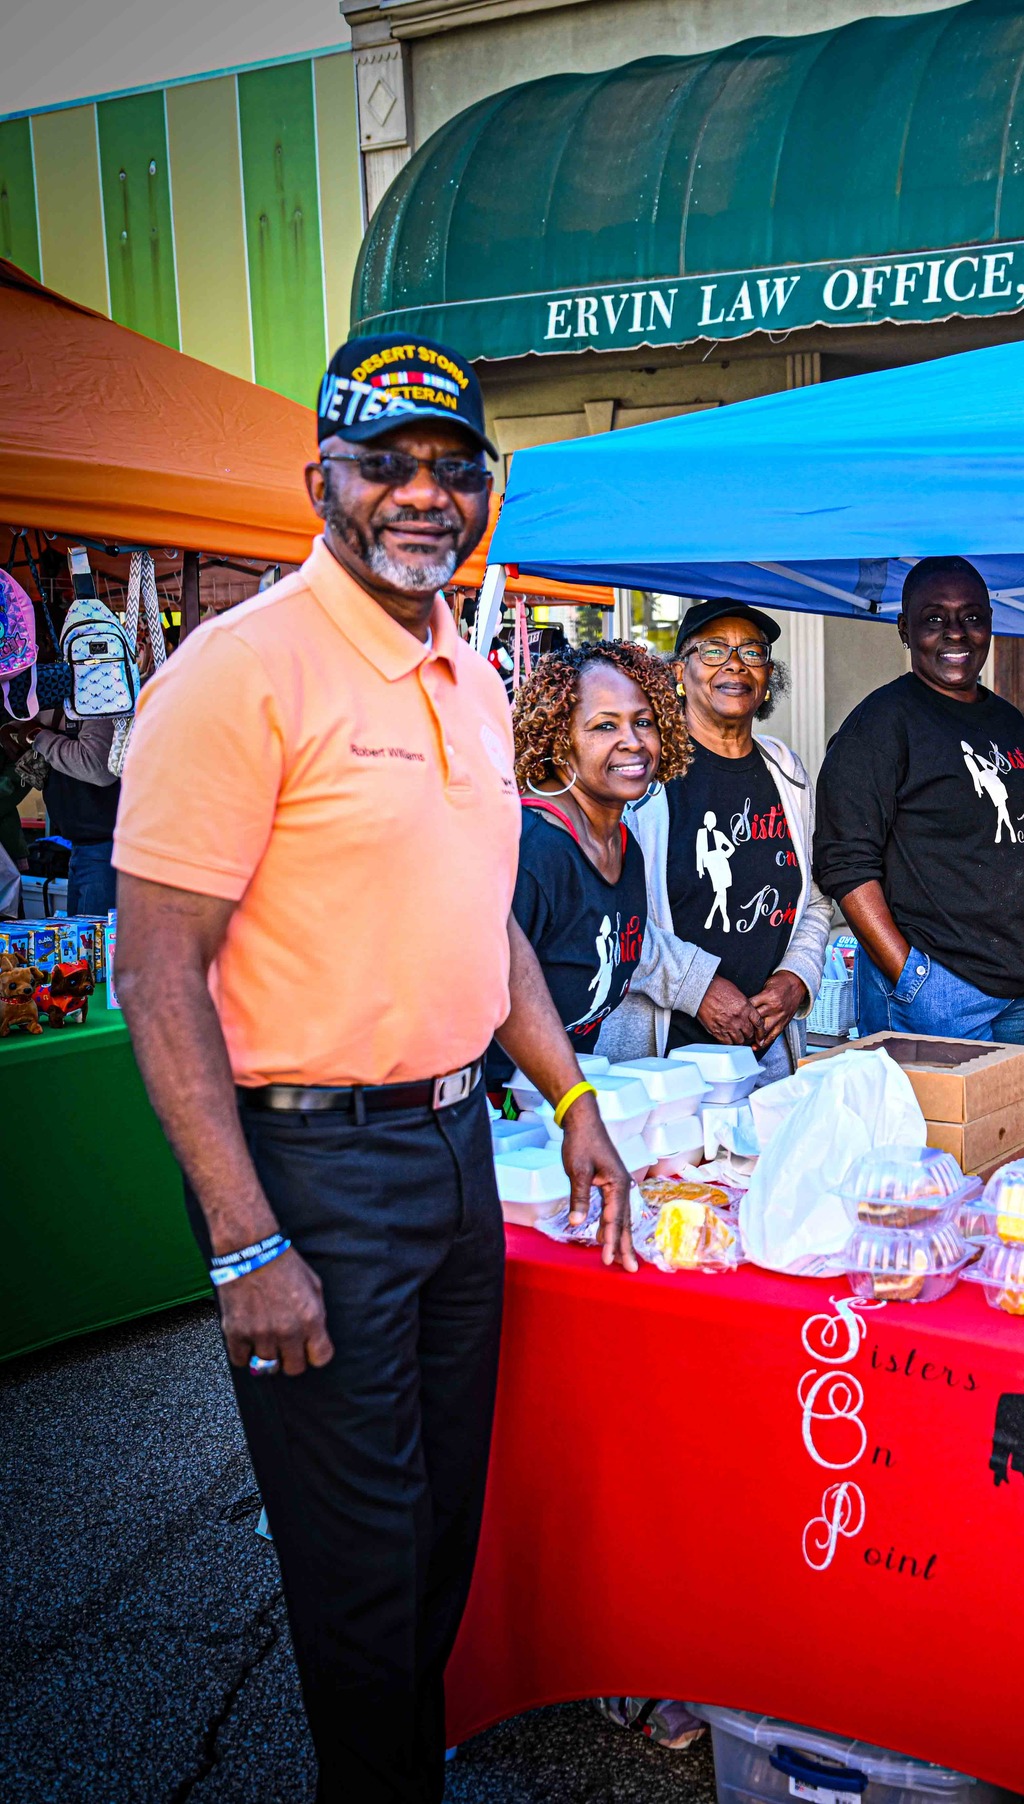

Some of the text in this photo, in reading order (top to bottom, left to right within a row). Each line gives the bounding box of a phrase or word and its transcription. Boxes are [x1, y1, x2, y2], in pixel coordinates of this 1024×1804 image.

[544, 287, 679, 341] ERVIN
[697, 274, 800, 327] LAW
[351, 344, 470, 390] DESERT STORM
[379, 385, 458, 411] VETERAN
[350, 743, 426, 763] Robert Williams
[801, 1294, 981, 1392] Sisters
[797, 1368, 896, 1470] On
[802, 1481, 938, 1581] Point
